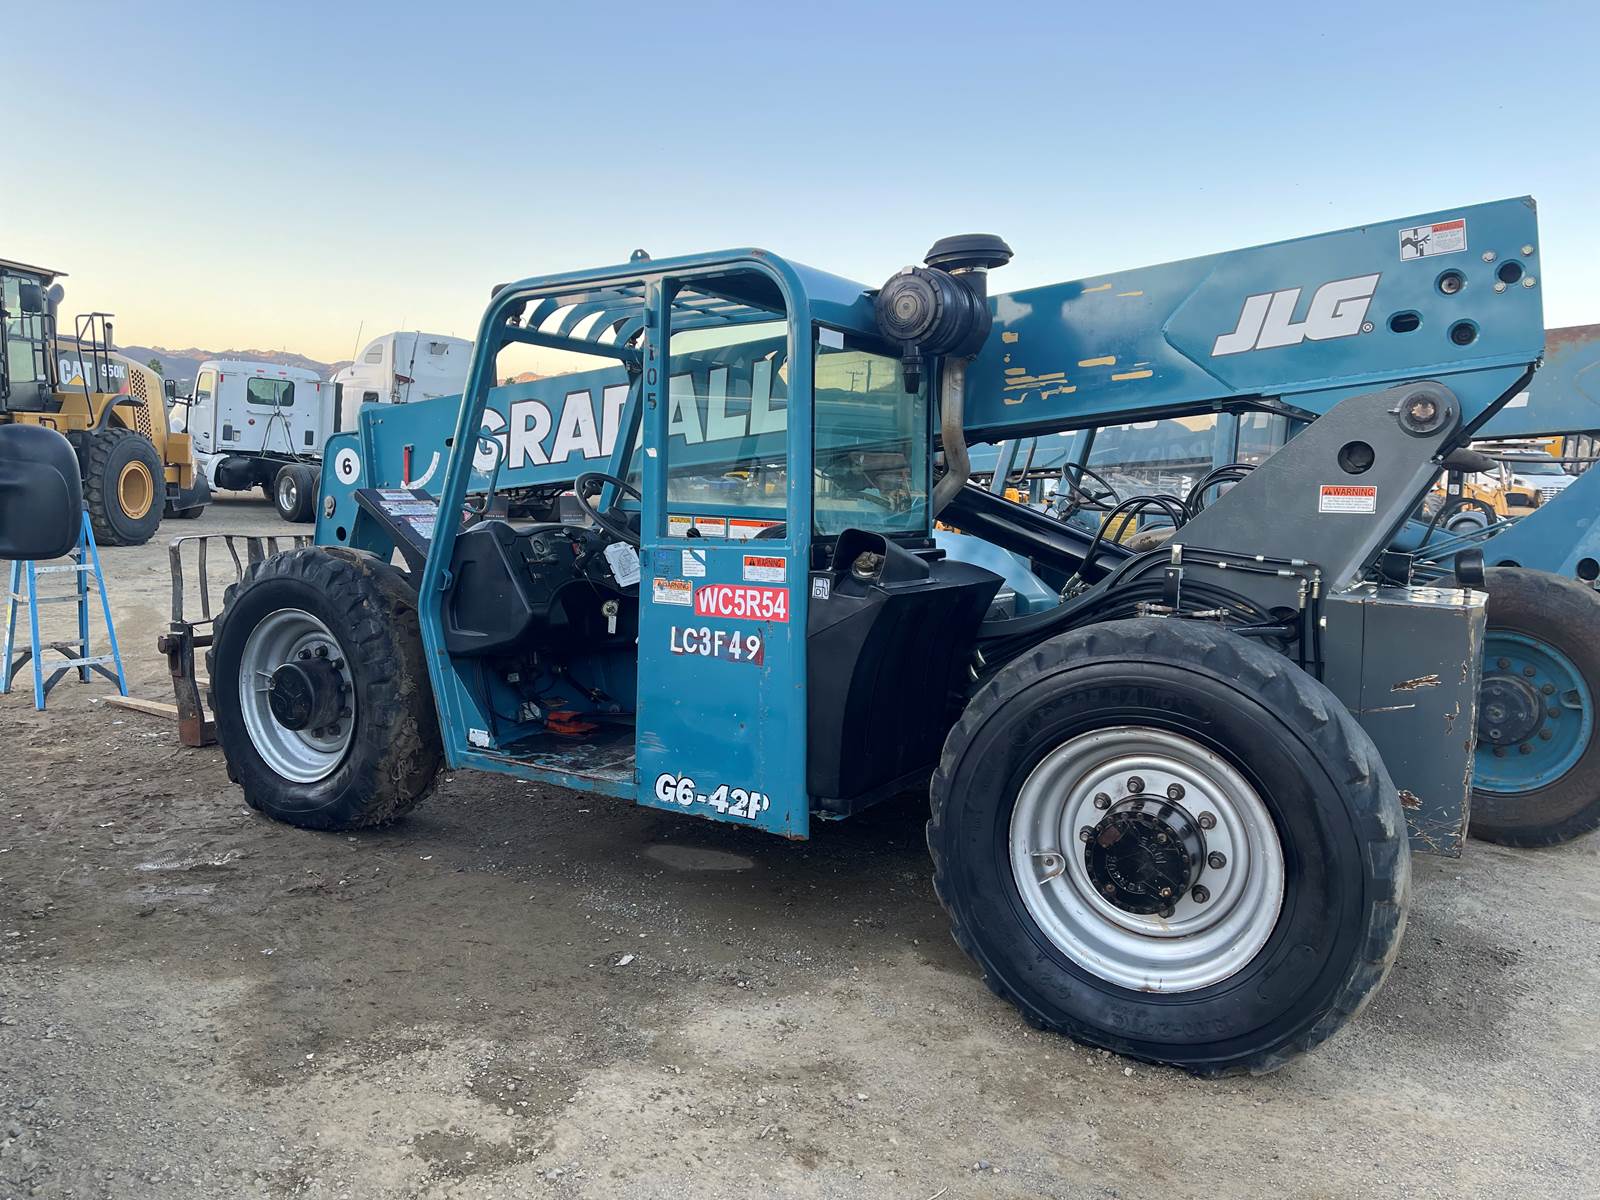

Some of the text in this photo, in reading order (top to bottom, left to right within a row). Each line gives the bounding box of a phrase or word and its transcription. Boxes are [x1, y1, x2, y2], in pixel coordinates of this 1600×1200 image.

[1211, 273, 1382, 356] JLG
[60, 360, 92, 387] CAT
[101, 363, 125, 379] 950K
[342, 458, 352, 475] 6
[1333, 488, 1374, 496] WARNING
[699, 587, 786, 619] WC5R54
[670, 626, 761, 660] LC3F49
[655, 772, 770, 820] G6-42P
